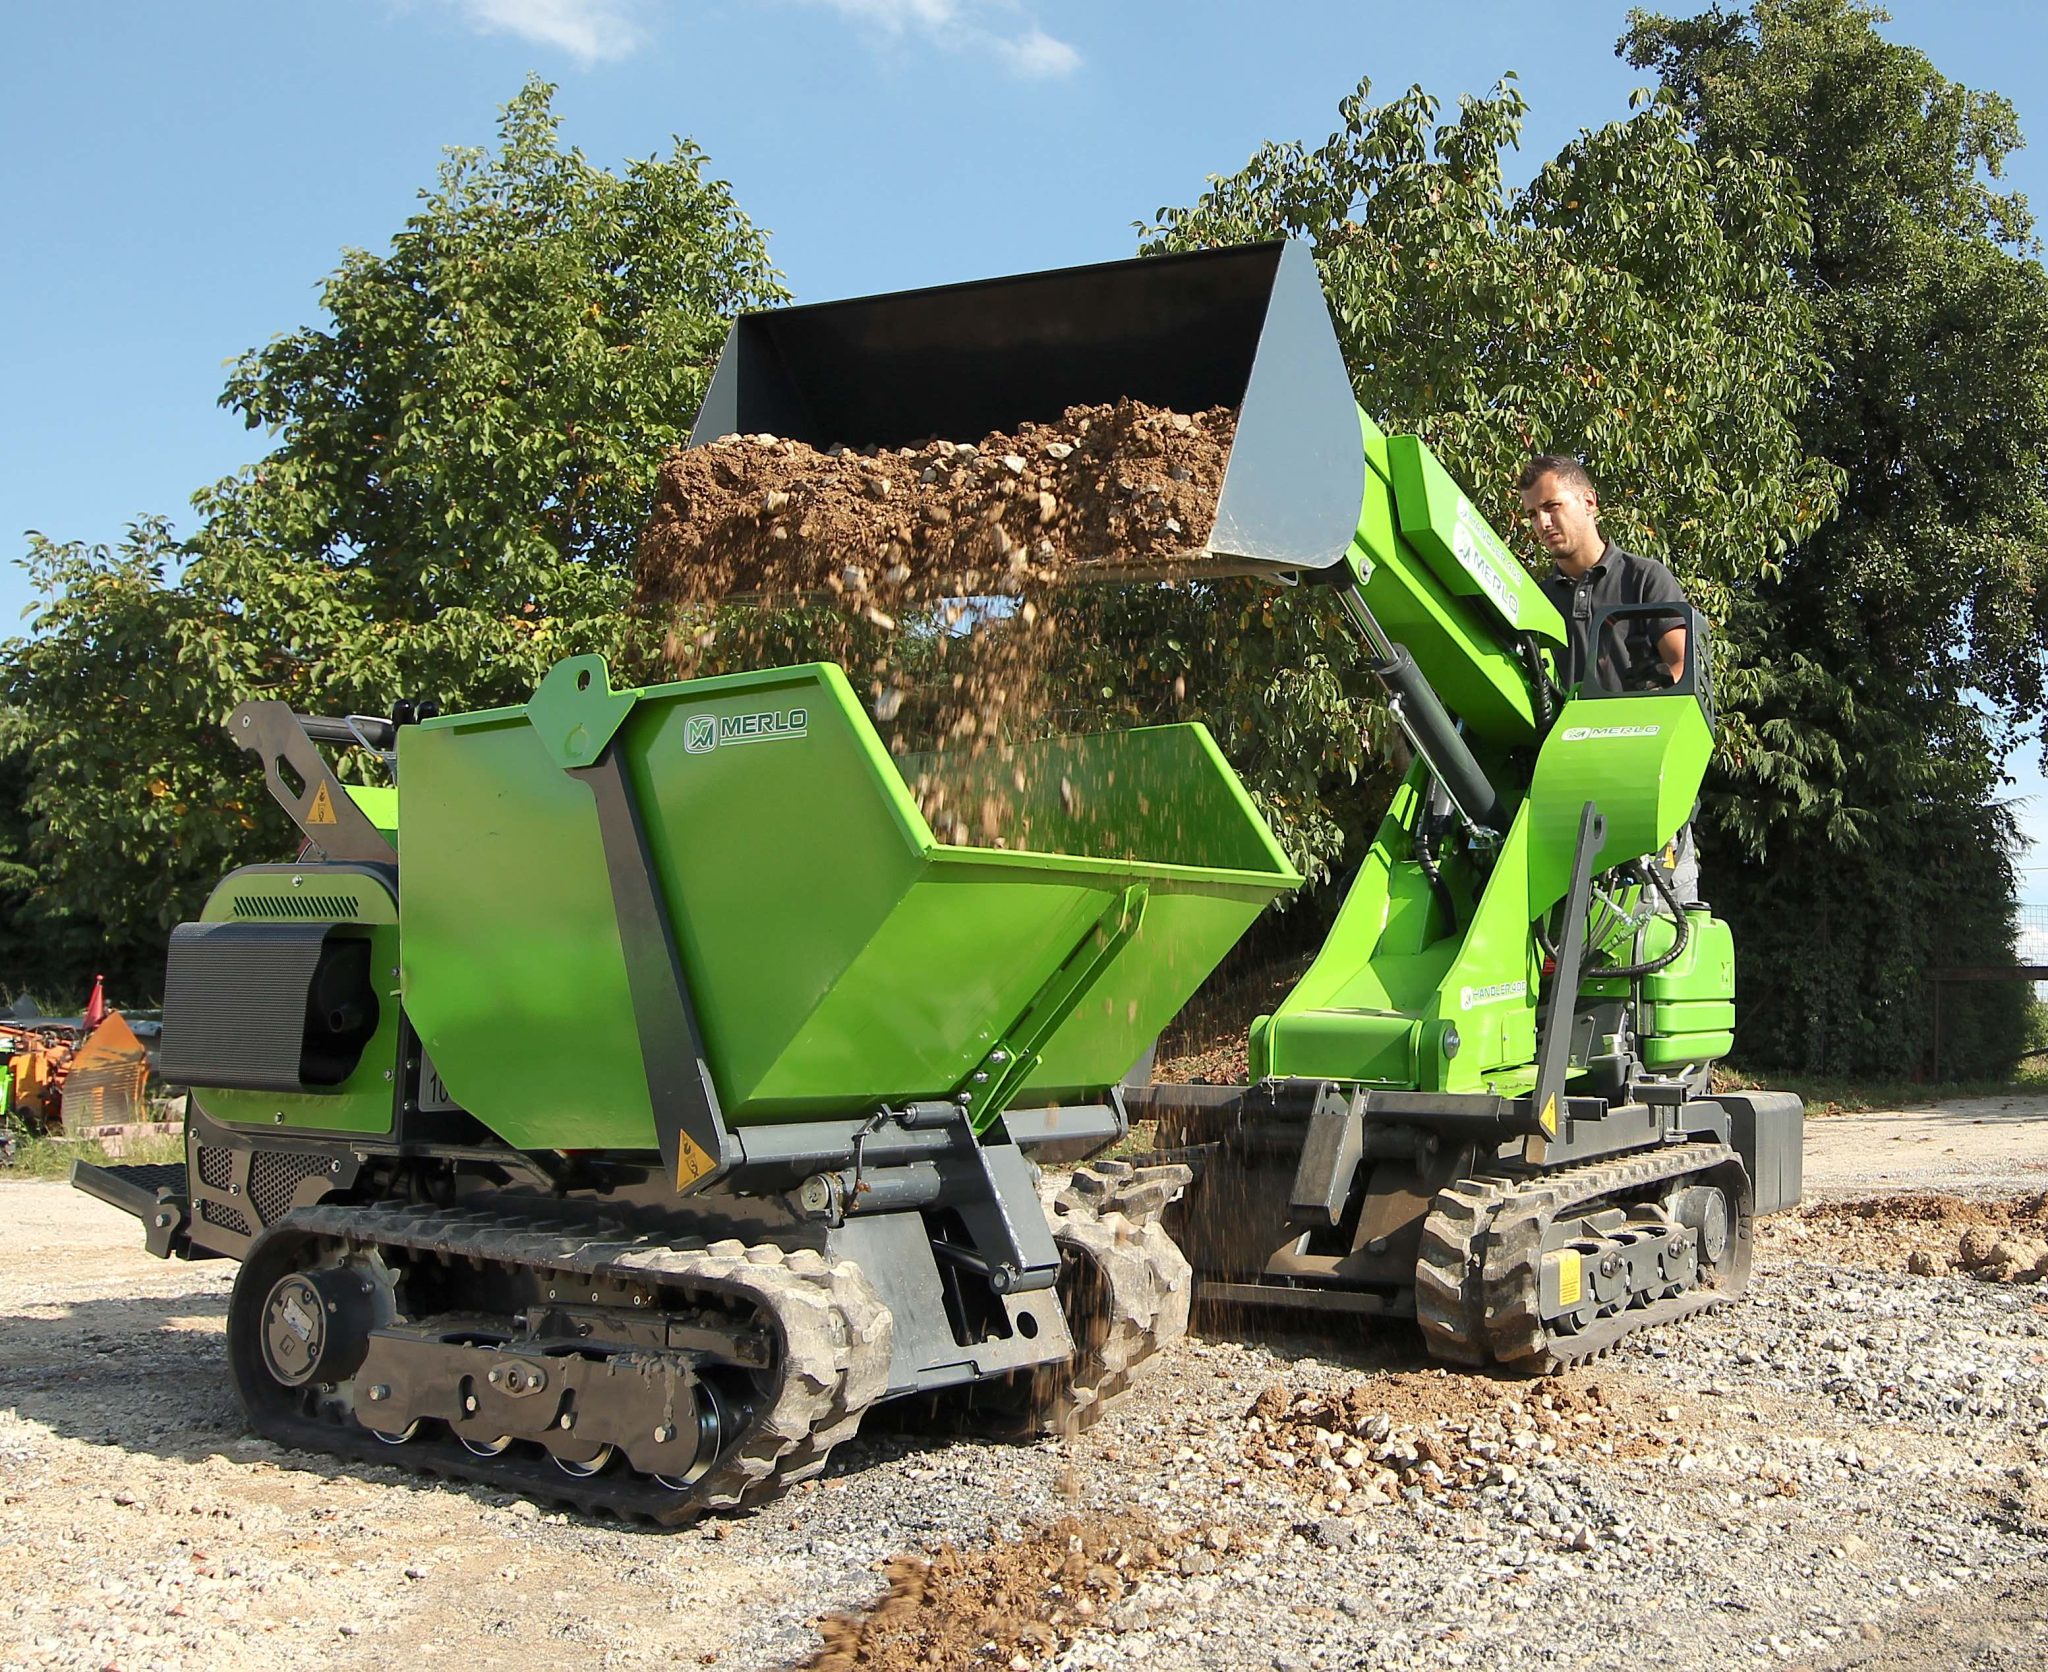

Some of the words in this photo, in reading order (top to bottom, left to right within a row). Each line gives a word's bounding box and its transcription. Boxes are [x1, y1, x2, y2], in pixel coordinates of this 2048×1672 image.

[1474, 550, 1518, 614] MERLO
[721, 709, 808, 737] MERLO
[1592, 726, 1658, 735] MERLO
[1472, 983, 1511, 1000] HANDLER
